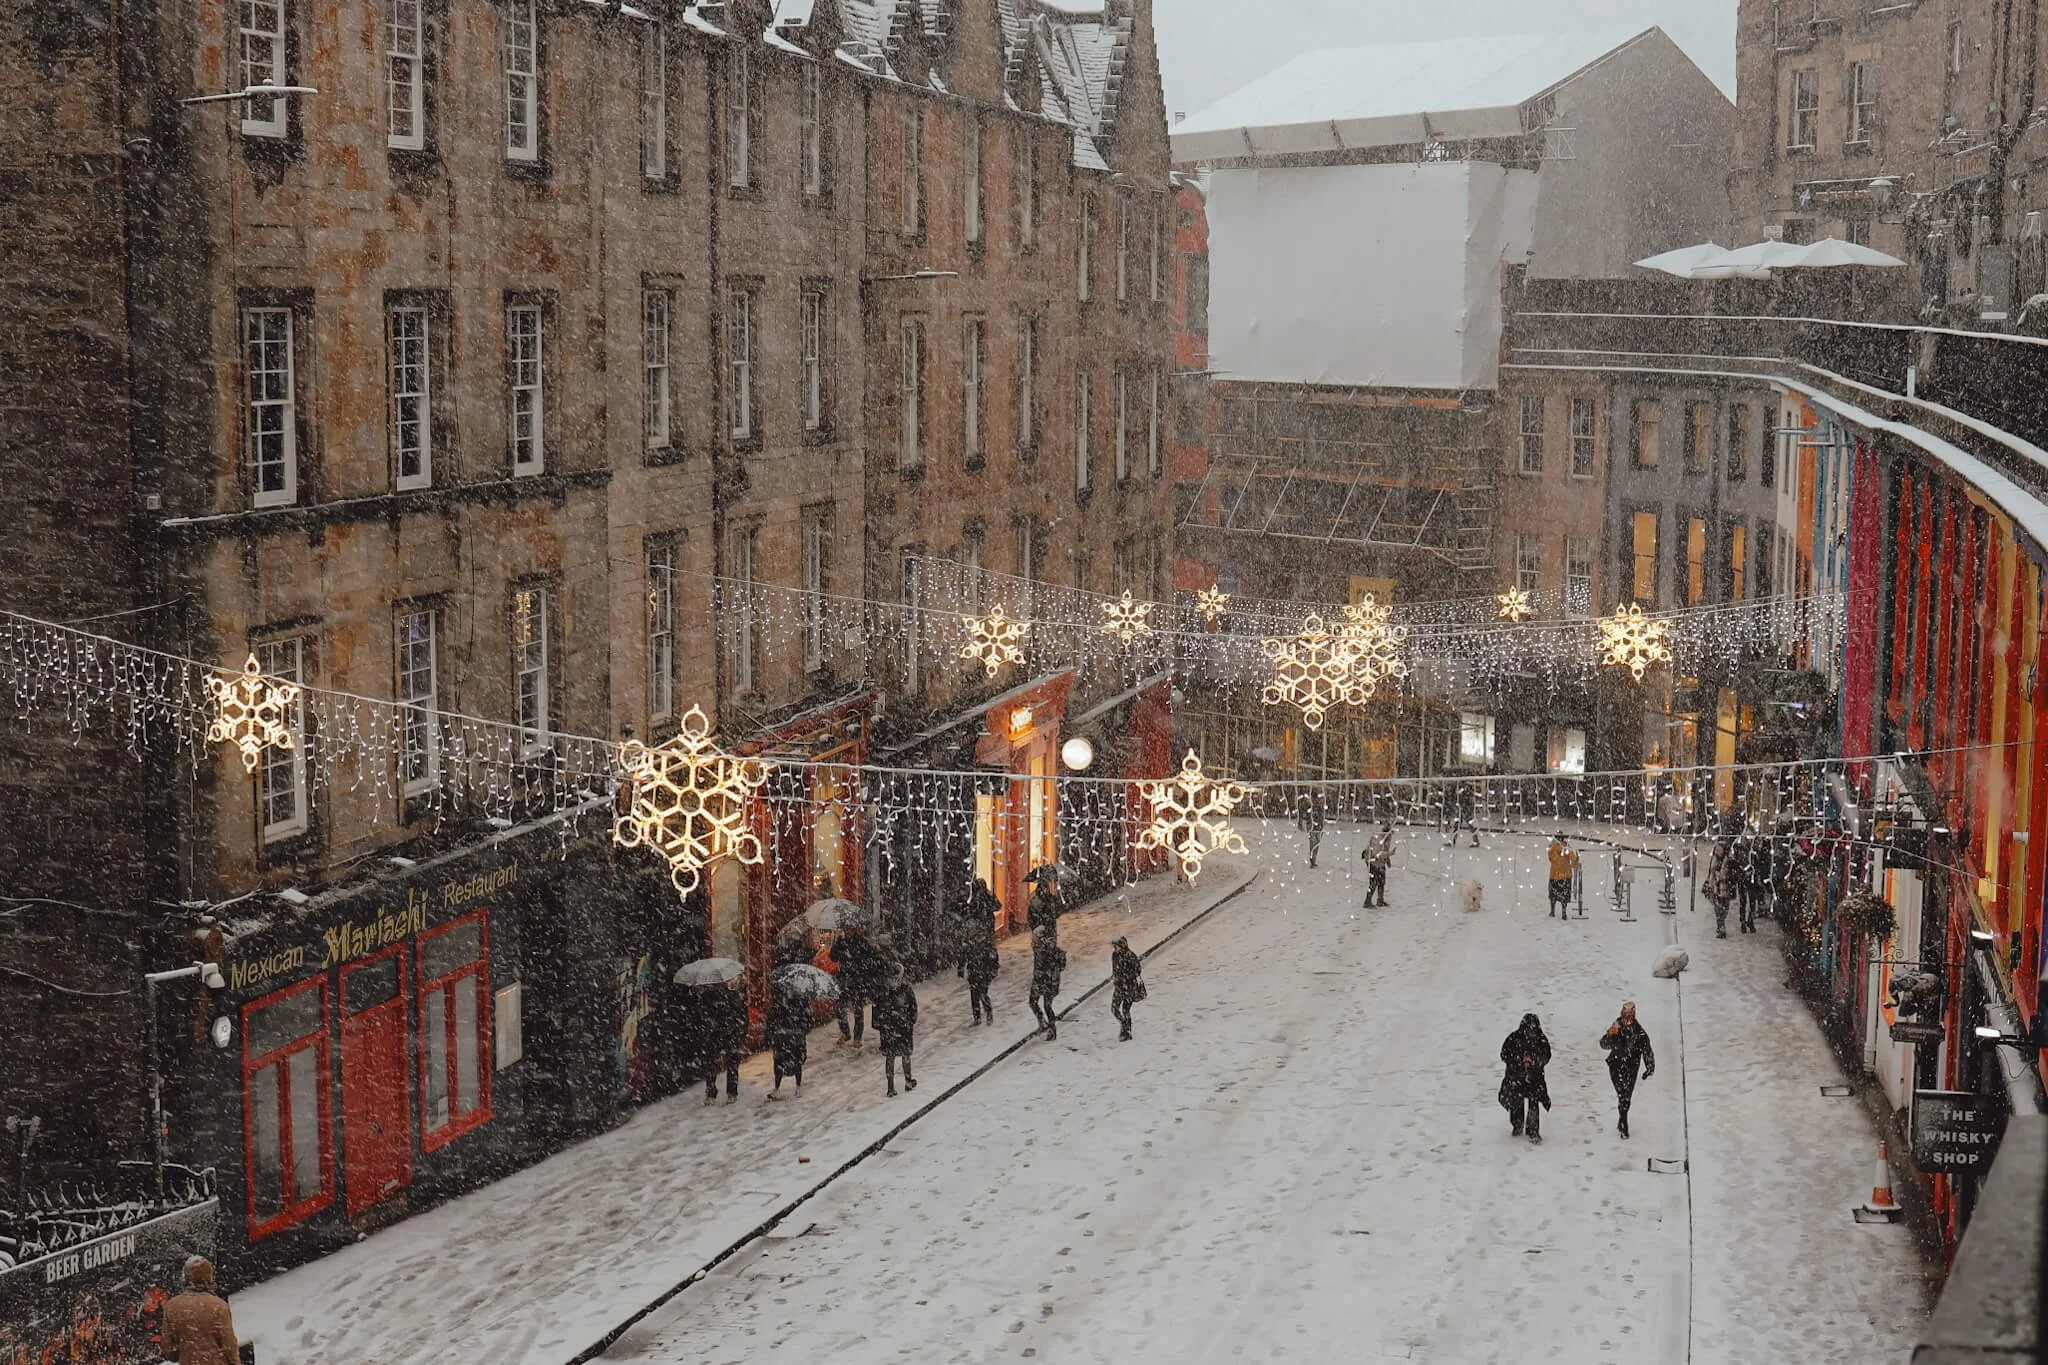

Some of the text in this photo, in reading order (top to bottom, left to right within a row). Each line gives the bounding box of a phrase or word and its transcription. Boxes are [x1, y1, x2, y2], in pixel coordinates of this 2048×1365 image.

[231, 860, 519, 991] Mexican Mariachi Restaurant
[1941, 1110, 1975, 1122] THE
[1924, 1131, 1993, 1144] WHISKY
[1932, 1152, 1979, 1164] SHOP
[46, 1234, 135, 1284] BEER GARDEN
